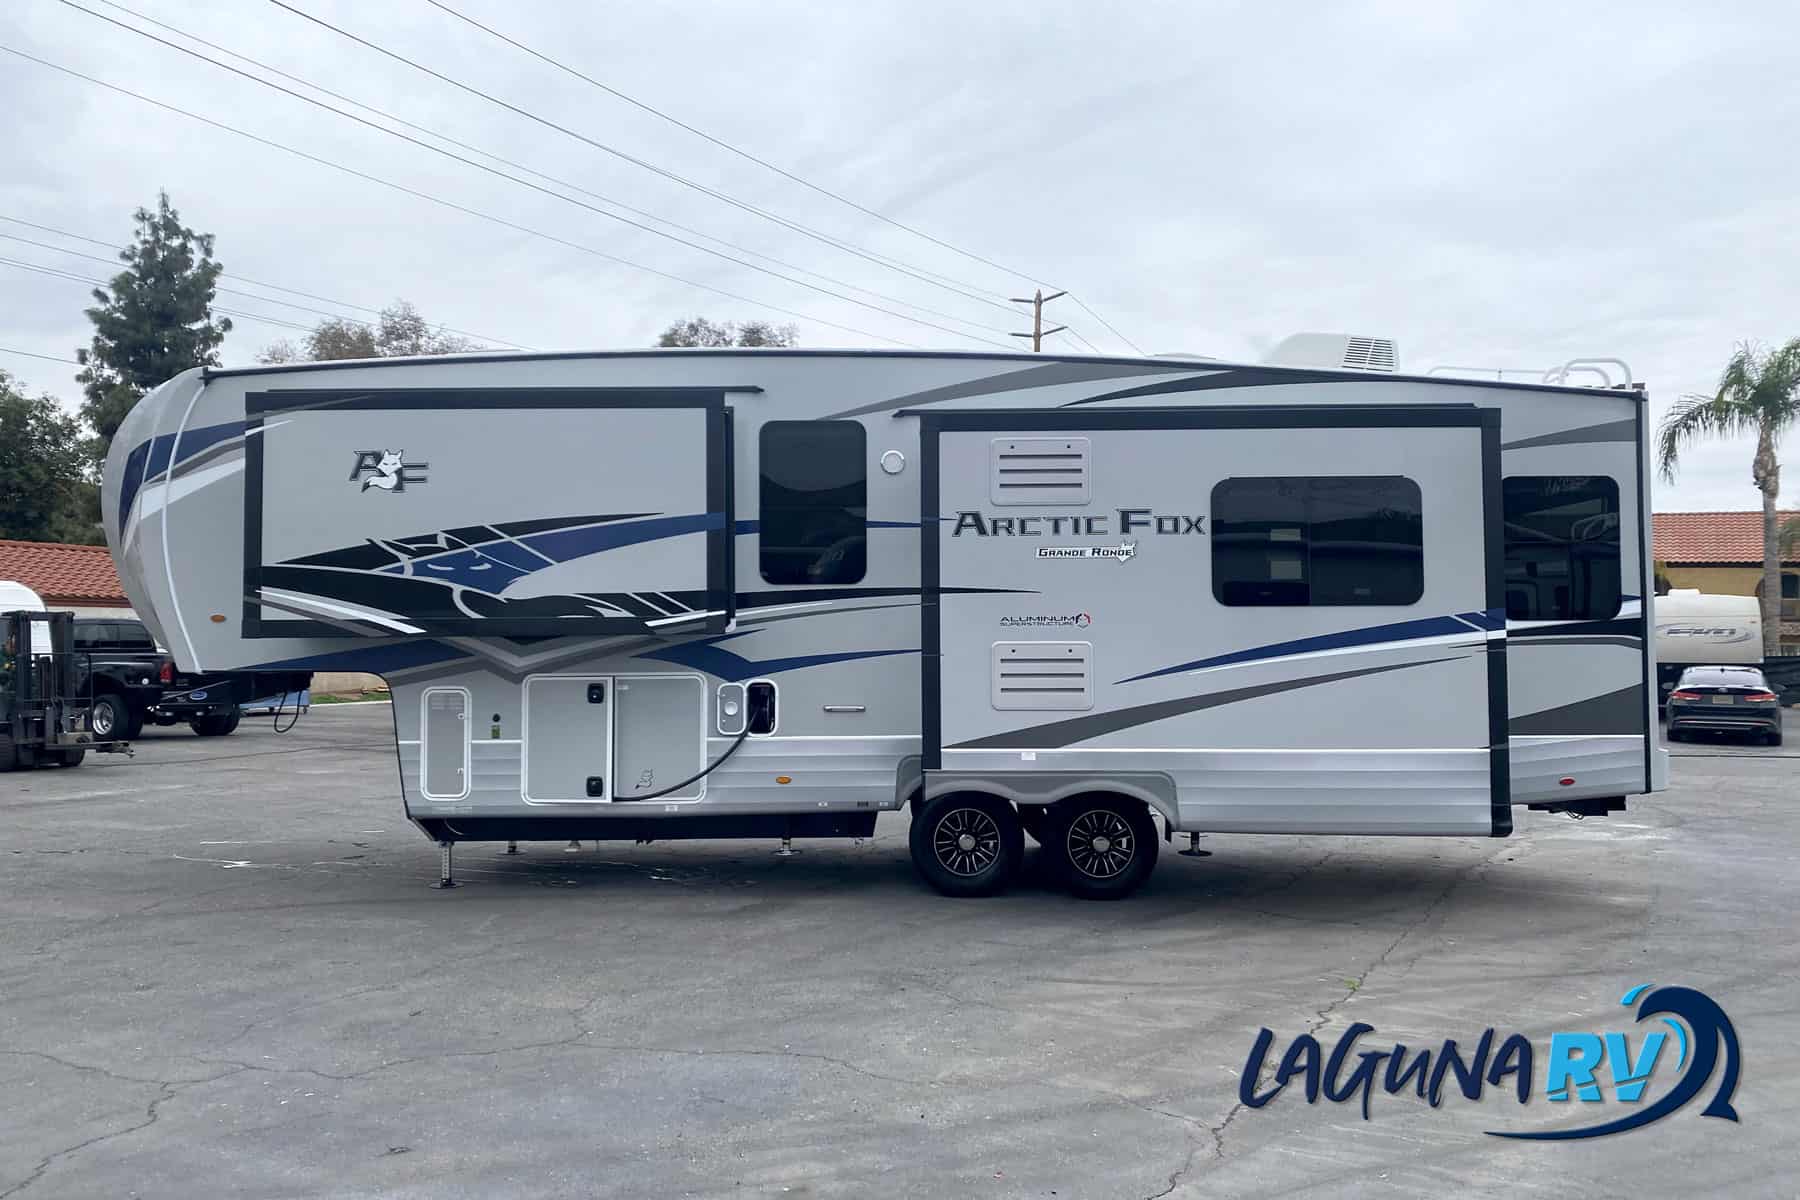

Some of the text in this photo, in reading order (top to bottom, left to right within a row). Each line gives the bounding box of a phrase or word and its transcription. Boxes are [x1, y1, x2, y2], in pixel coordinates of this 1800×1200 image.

[953, 508, 1207, 537] ARCTIC FOX
[1038, 547, 1133, 557] GRANDE RONDE
